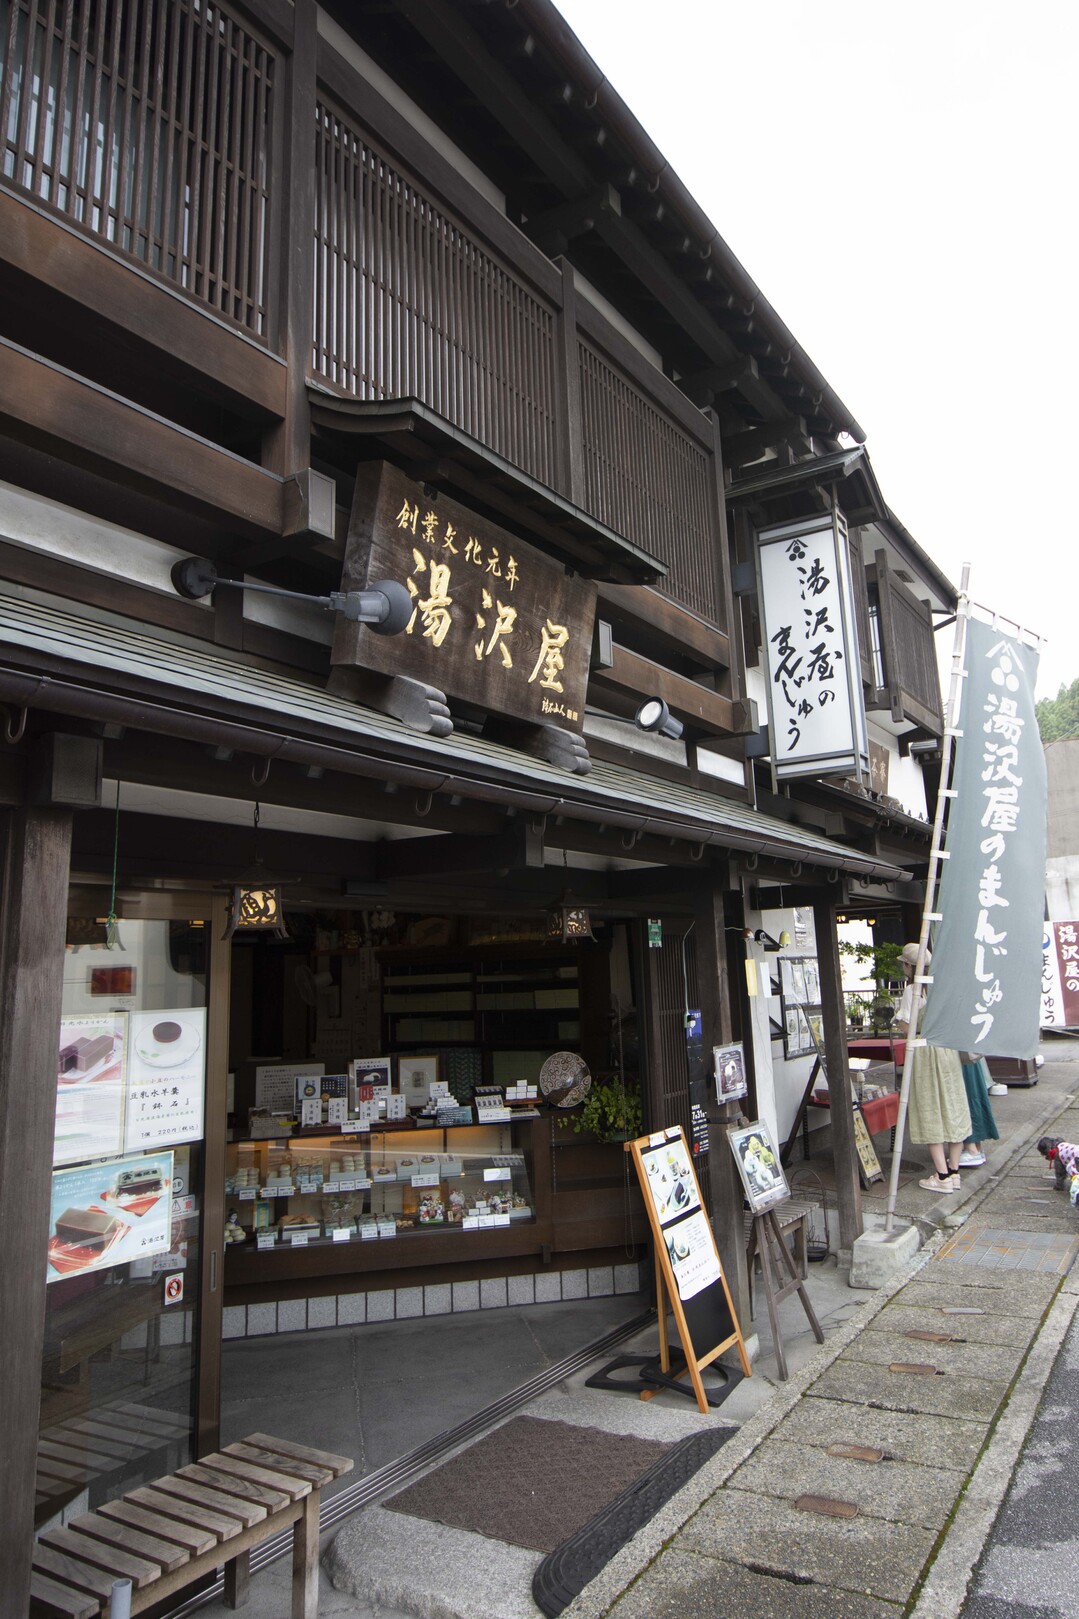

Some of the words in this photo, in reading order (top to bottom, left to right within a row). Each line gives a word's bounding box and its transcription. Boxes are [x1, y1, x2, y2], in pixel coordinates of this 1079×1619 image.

[396, 498, 520, 591] 創業文化元年
[405, 547, 570, 693] 湯沢屋
[797, 558, 843, 708] 湯沢屋の
[770, 625, 814, 752] まんじゅう
[970, 692, 1025, 1045] 湯沢屋のまんじゅう
[1058, 924, 1079, 992] 湯沢屋の
